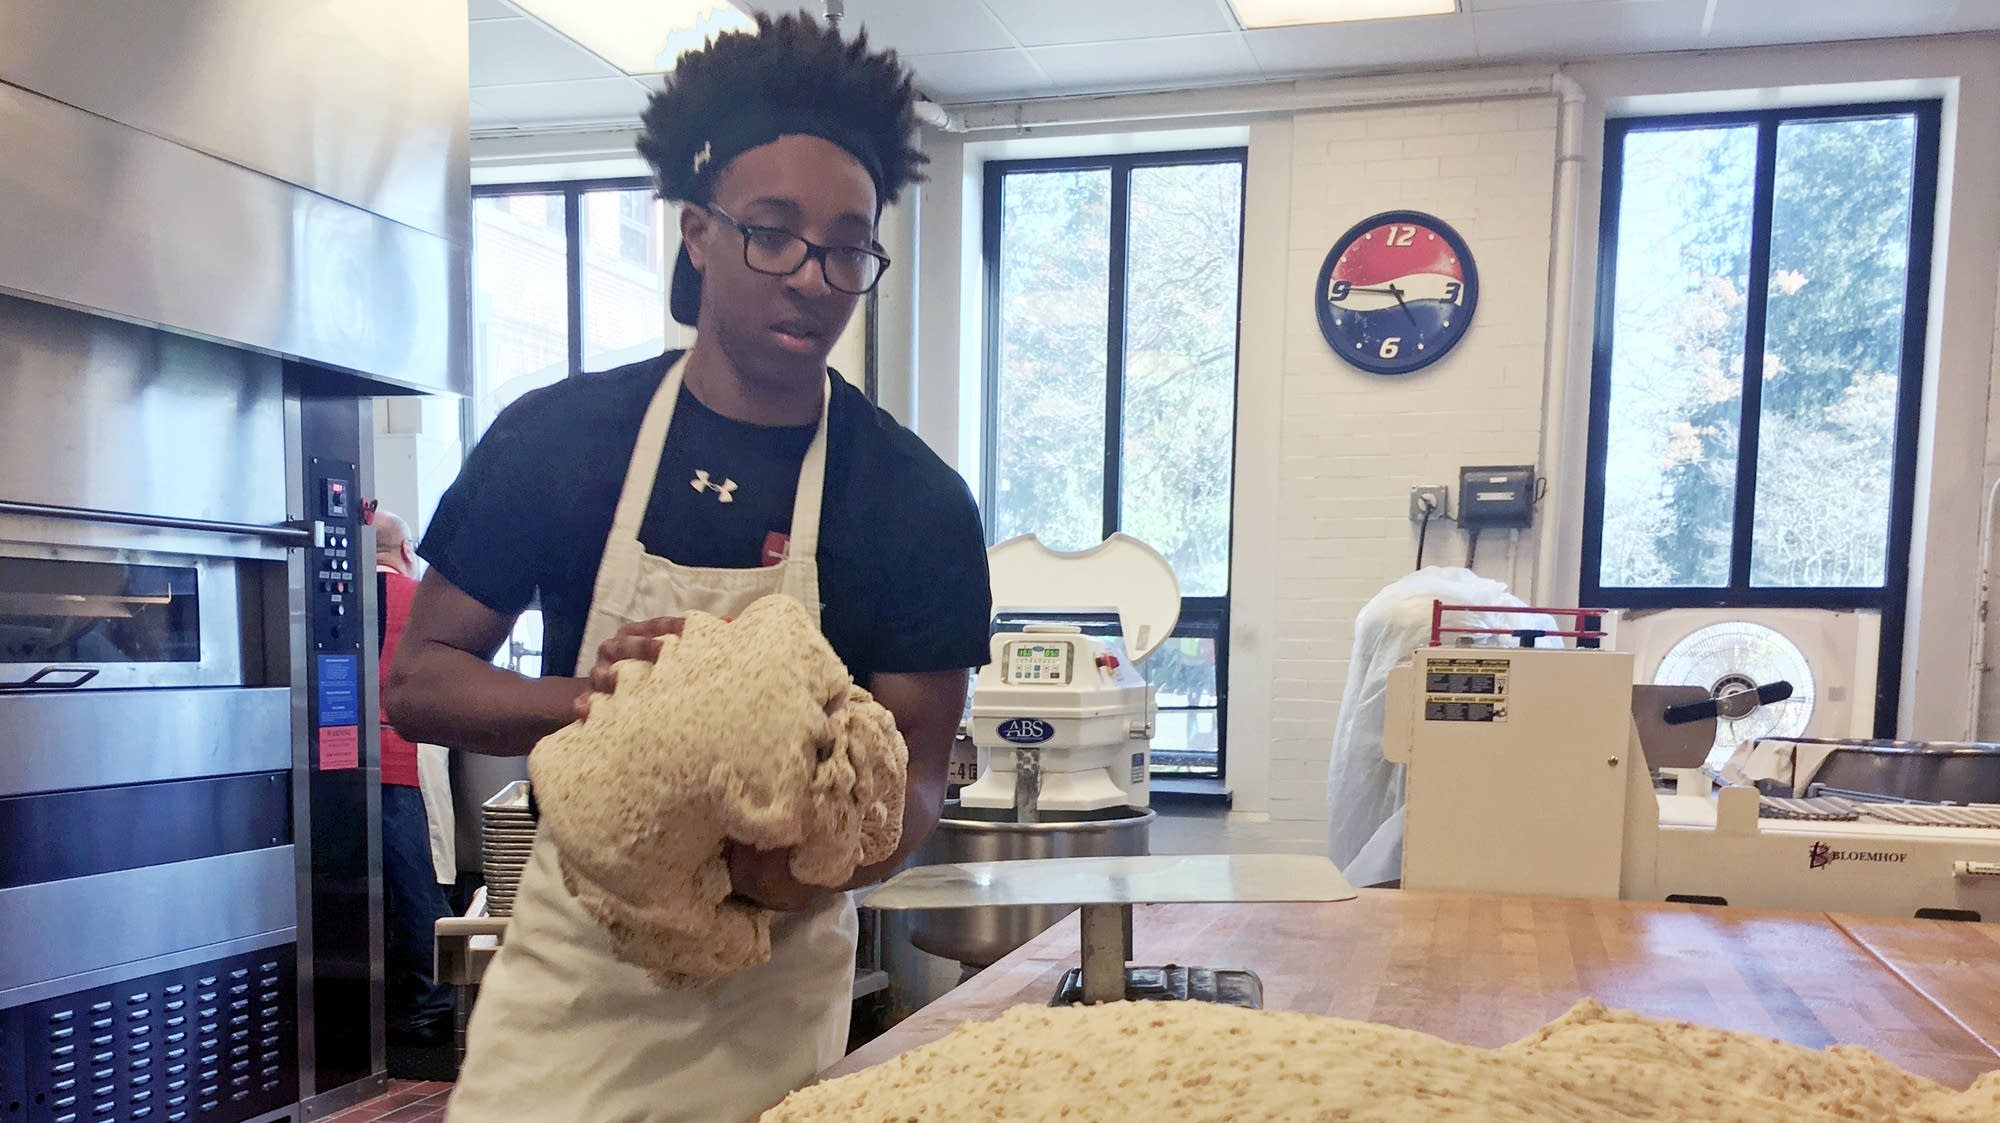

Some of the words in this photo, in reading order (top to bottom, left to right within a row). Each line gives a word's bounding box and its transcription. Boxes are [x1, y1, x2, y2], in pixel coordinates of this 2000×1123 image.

[1386, 226, 1417, 247] 12
[1330, 280, 1351, 302] 9
[1440, 282, 1462, 304] 3
[1379, 336, 1401, 359] 6
[1006, 720, 1044, 737] ABS
[1832, 850, 1908, 863] BLOEMHOF
